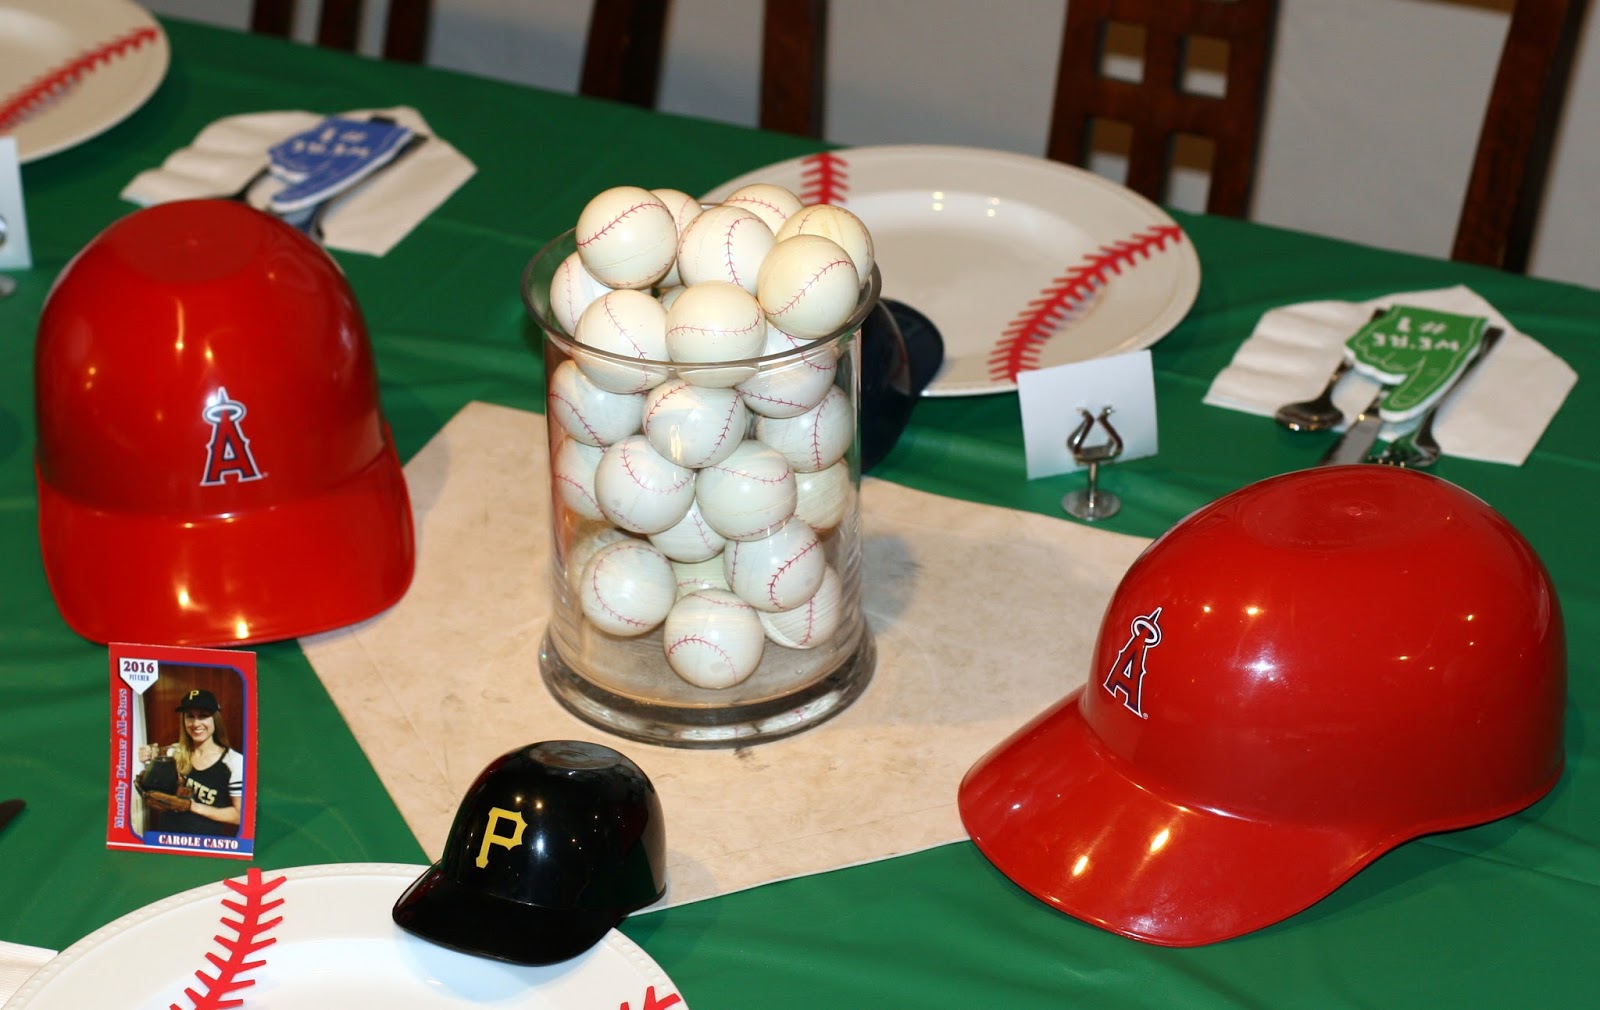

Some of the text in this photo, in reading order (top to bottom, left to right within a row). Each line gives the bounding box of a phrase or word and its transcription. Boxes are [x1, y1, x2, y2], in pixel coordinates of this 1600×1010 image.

[200, 386, 262, 486] A
[123, 660, 155, 674] 2016
[1103, 606, 1163, 718] A
[189, 690, 200, 700] P
[114, 688, 128, 829] Monthly Dinner All-Stars
[158, 834, 239, 850] CAROLE CASTO
[475, 806, 528, 869] P
